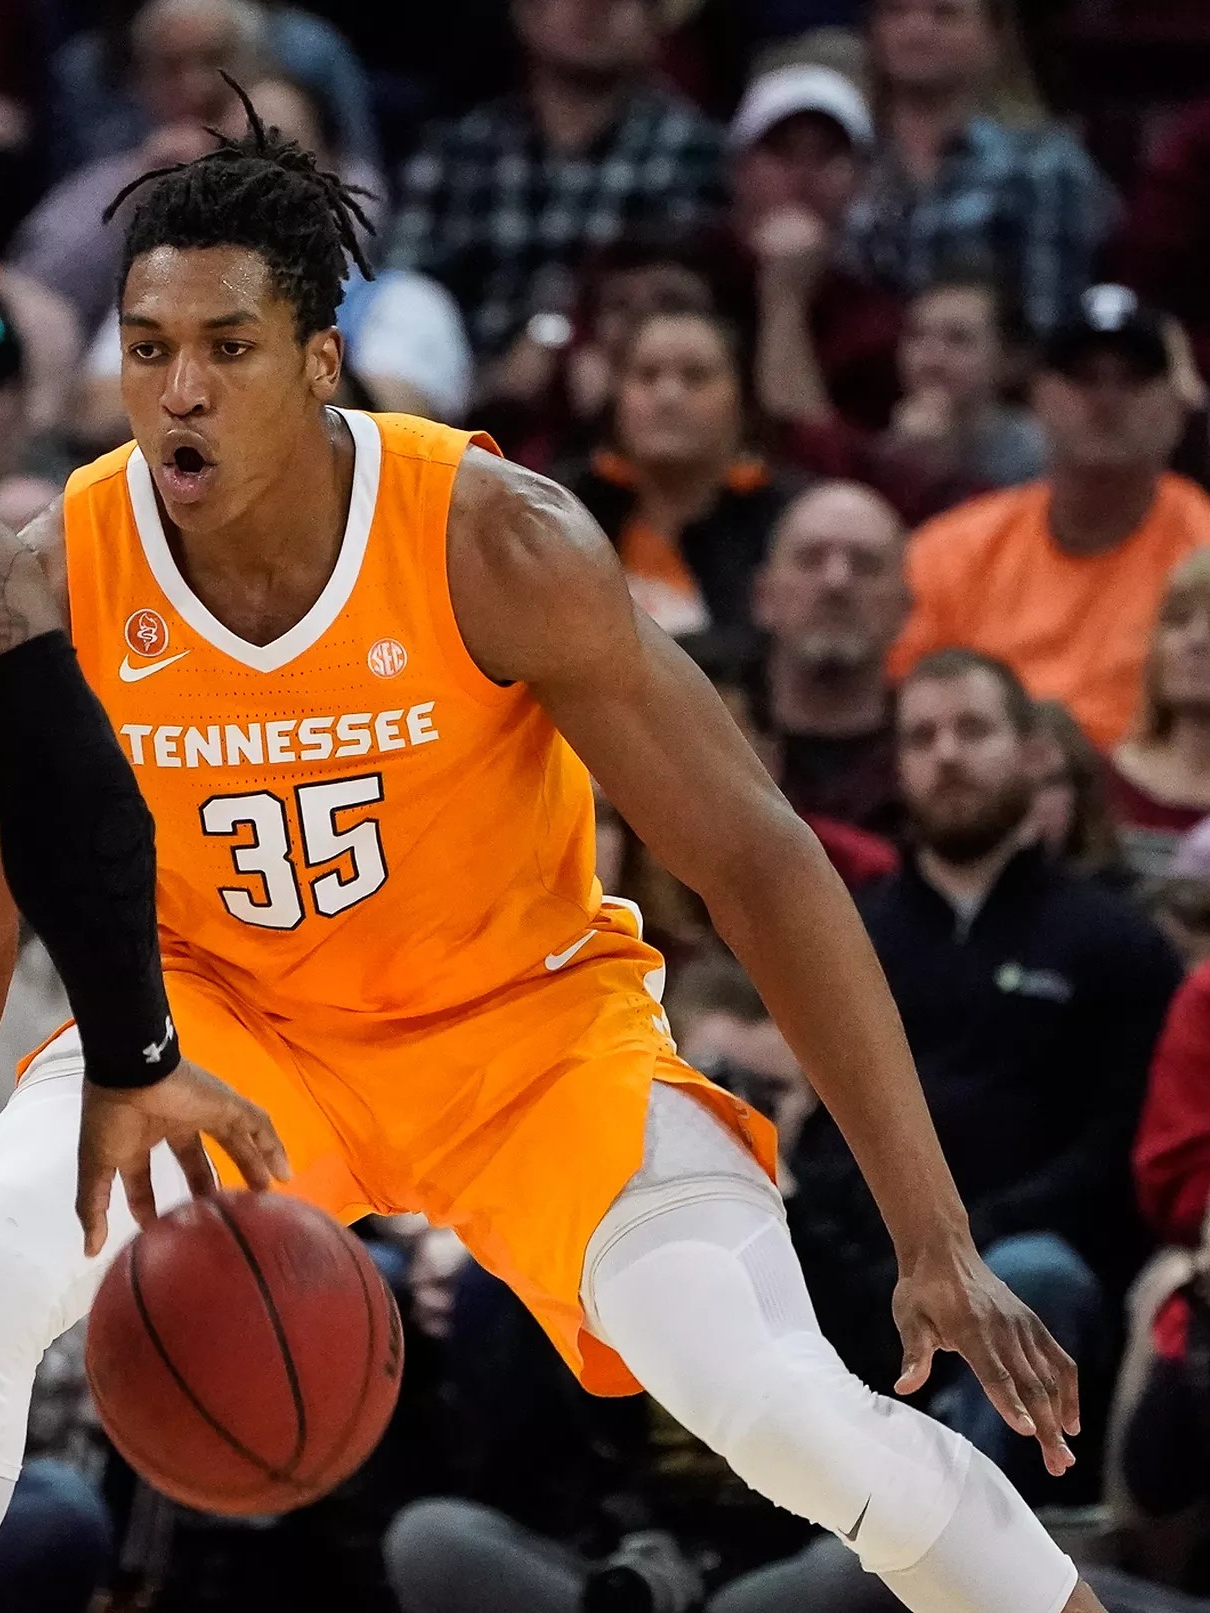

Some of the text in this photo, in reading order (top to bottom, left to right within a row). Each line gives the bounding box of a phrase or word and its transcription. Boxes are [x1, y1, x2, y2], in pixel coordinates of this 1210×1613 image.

[370, 640, 405, 677] SEC
[119, 701, 440, 768] TENNESSEE
[198, 771, 389, 931] 35
